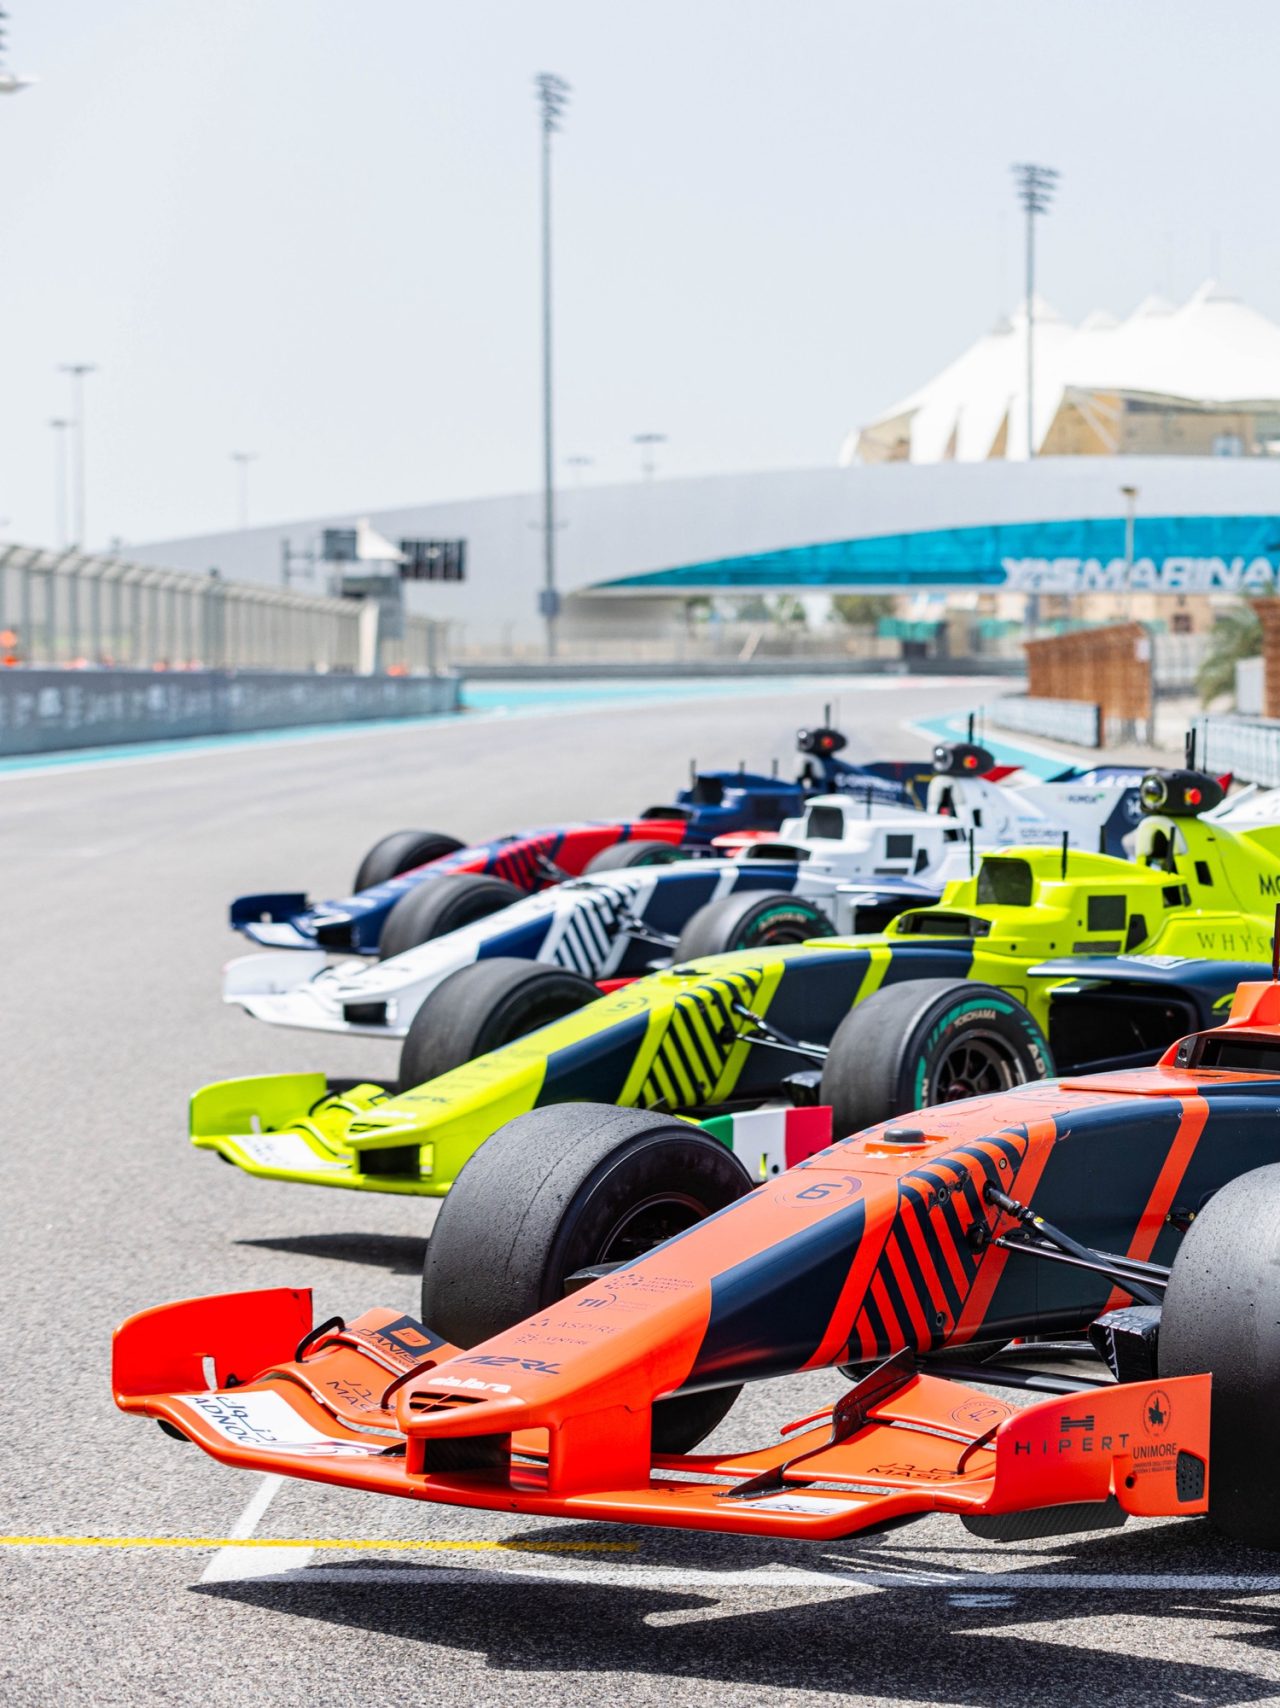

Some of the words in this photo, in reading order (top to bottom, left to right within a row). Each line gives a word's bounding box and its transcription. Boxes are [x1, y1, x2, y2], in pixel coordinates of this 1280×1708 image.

[1083, 556, 1276, 595] MARINA
[953, 1009, 997, 1028] YOKOHAMA
[428, 1376, 512, 1394] dallara
[187, 1396, 260, 1443] ADNOC
[1014, 1433, 1130, 1455] HIPERT
[1132, 1442, 1177, 1460] UNIMORE
